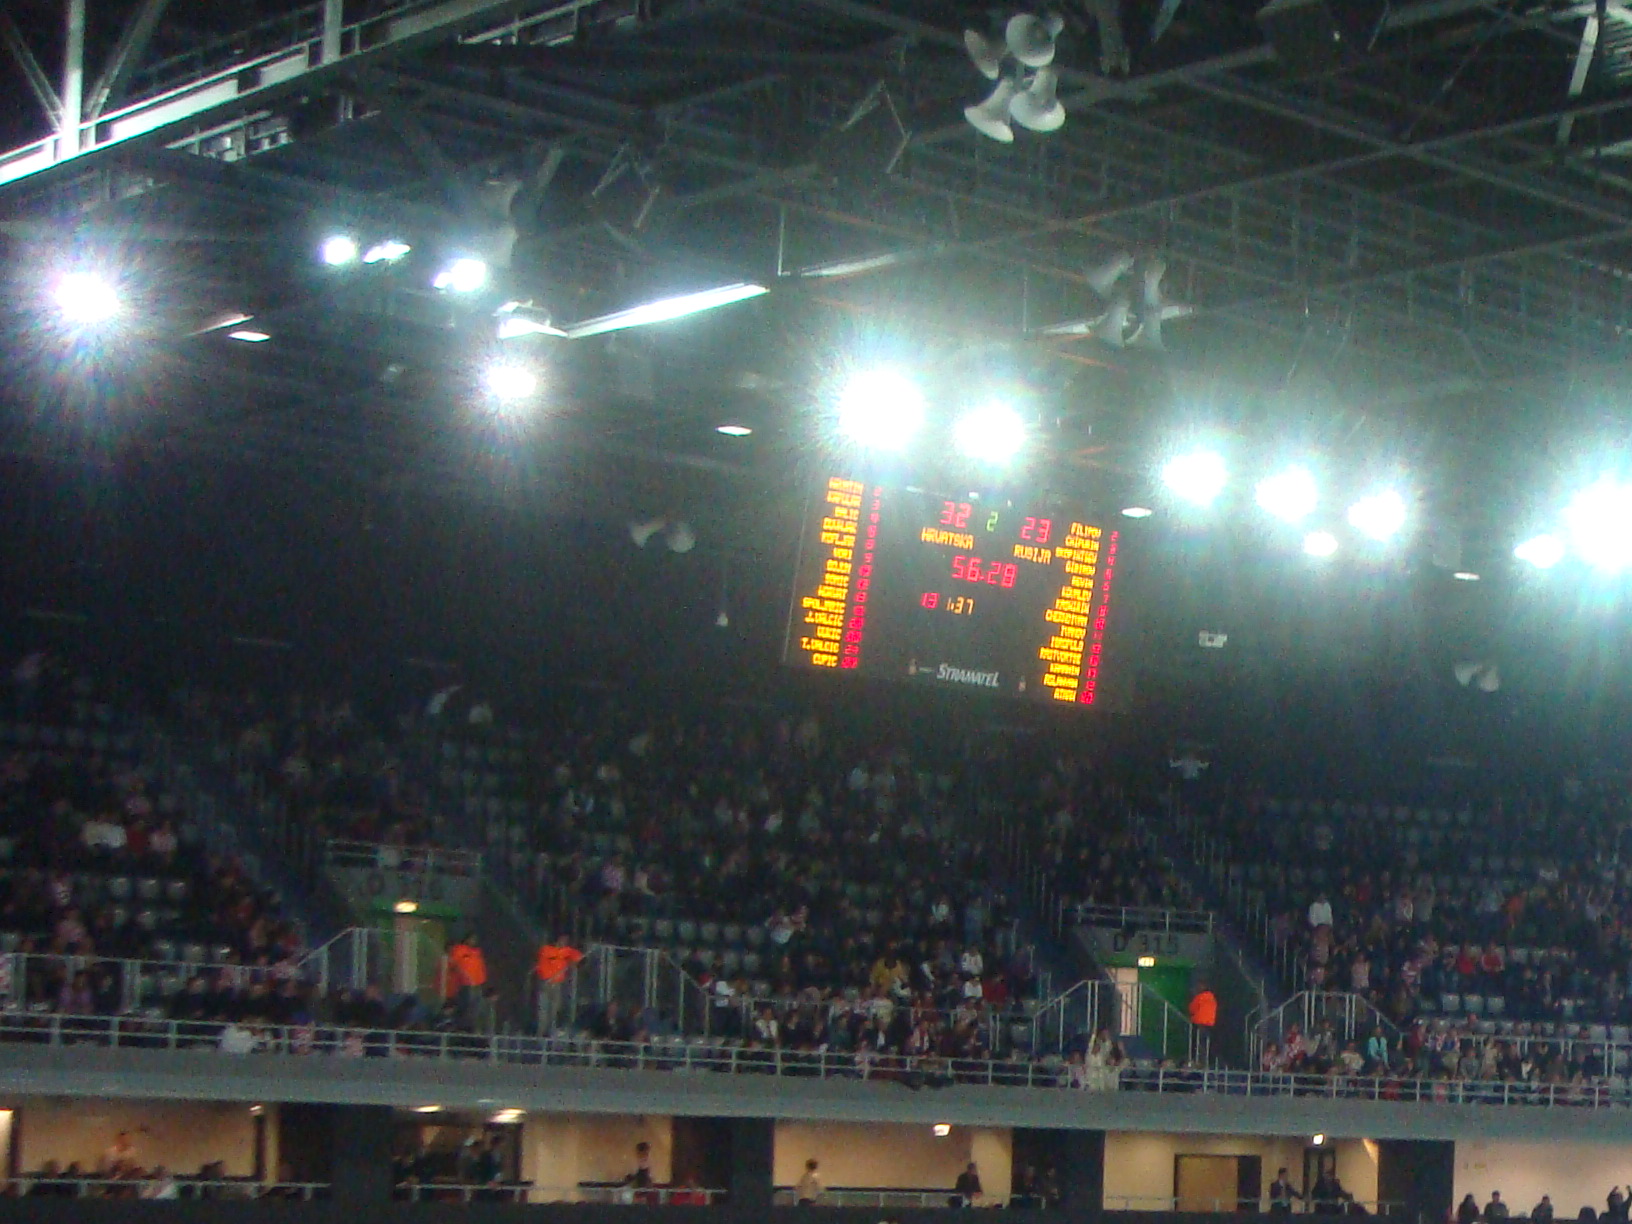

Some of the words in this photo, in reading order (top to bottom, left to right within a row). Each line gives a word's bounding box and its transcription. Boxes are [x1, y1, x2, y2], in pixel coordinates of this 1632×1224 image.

[940, 501, 972, 528] 32
[986, 511, 998, 532] 2
[921, 527, 974, 550] HRVATSKA
[1020, 517, 1052, 543] 23
[1013, 544, 1051, 565] RUSIJA
[937, 663, 999, 687] STRAMATEL
